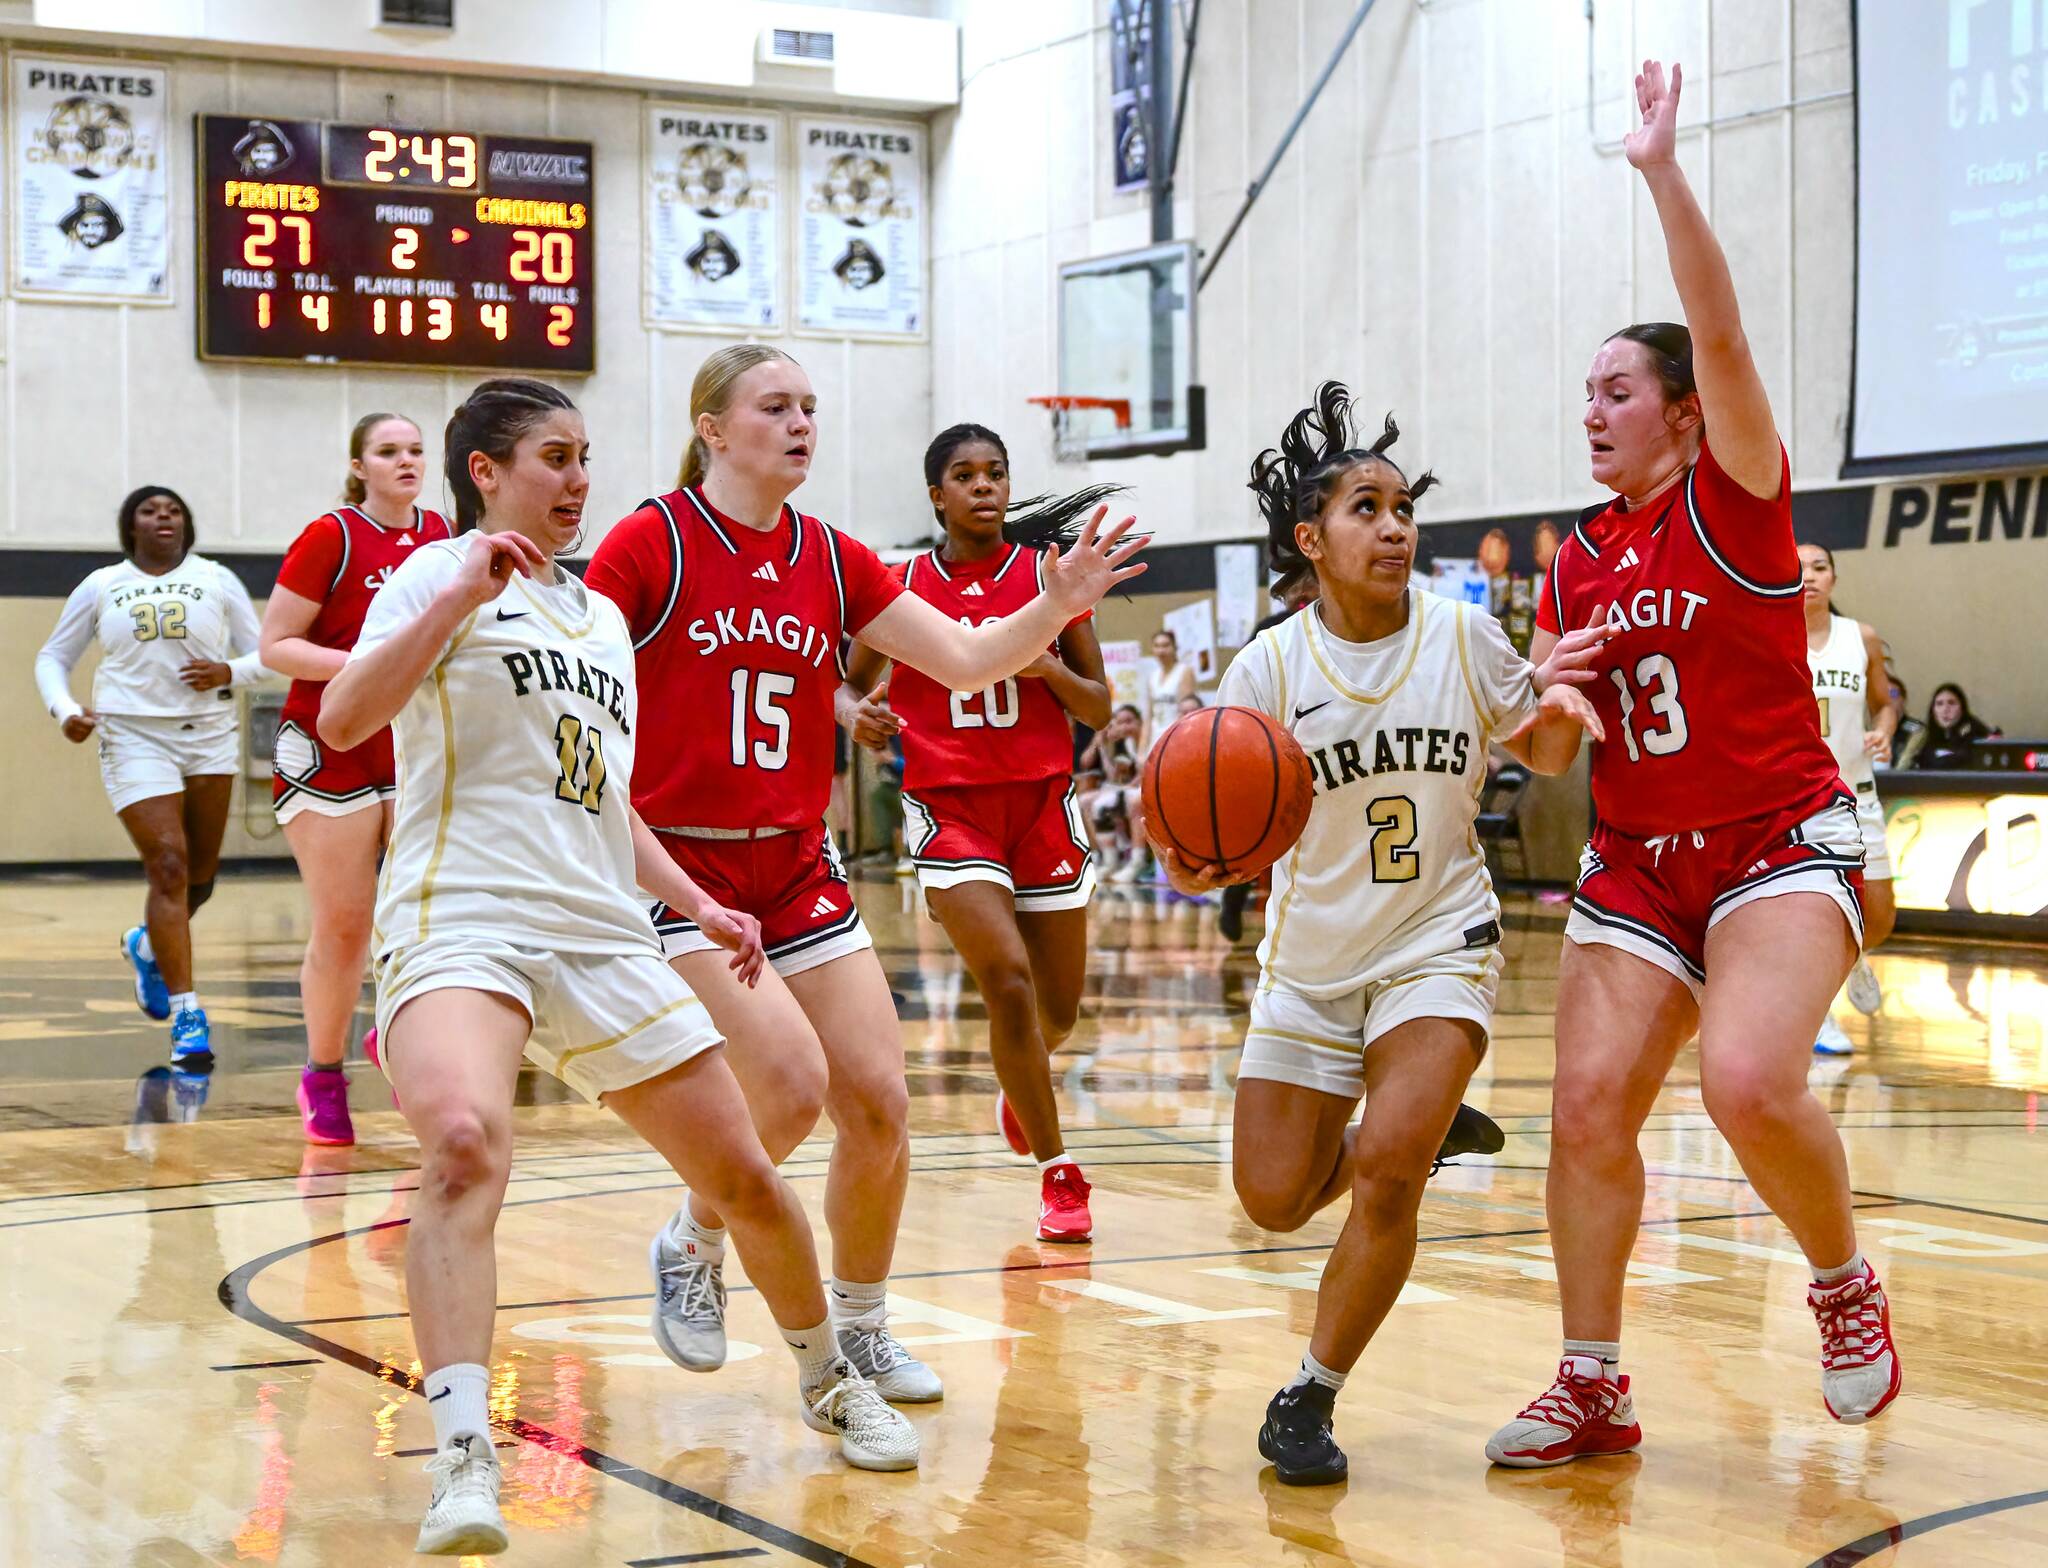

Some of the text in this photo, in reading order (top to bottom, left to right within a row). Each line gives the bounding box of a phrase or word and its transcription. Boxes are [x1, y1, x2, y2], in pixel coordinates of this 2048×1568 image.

[29, 70, 154, 97] PIRATES
[1948, 61, 2048, 129] CAS
[660, 118, 767, 142] PIRATES
[808, 129, 911, 153] PIRATES
[365, 130, 476, 188] 2:43
[489, 150, 588, 184] NWAC
[225, 180, 320, 212] PIRATES
[375, 203, 434, 226] PERIOD
[475, 197, 586, 229] CARDINALS
[244, 214, 311, 266] 27
[391, 228, 418, 270] 2
[510, 230, 573, 283] 20
[222, 268, 277, 290] FOULS
[354, 275, 459, 299] PLAYER FOUL
[528, 285, 580, 305] FOULS
[258, 292, 270, 329] 1
[301, 294, 330, 332] 4
[480, 303, 507, 341] 4
[547, 305, 573, 346] 2
[114, 582, 204, 608] PIRATES
[1597, 588, 1708, 640] AGIT
[129, 600, 187, 642] 32
[688, 607, 829, 668] SKAGIT
[731, 669, 795, 770] 15
[1610, 654, 1688, 762] 13
[554, 713, 606, 815] 11
[1366, 795, 1420, 883] 2
